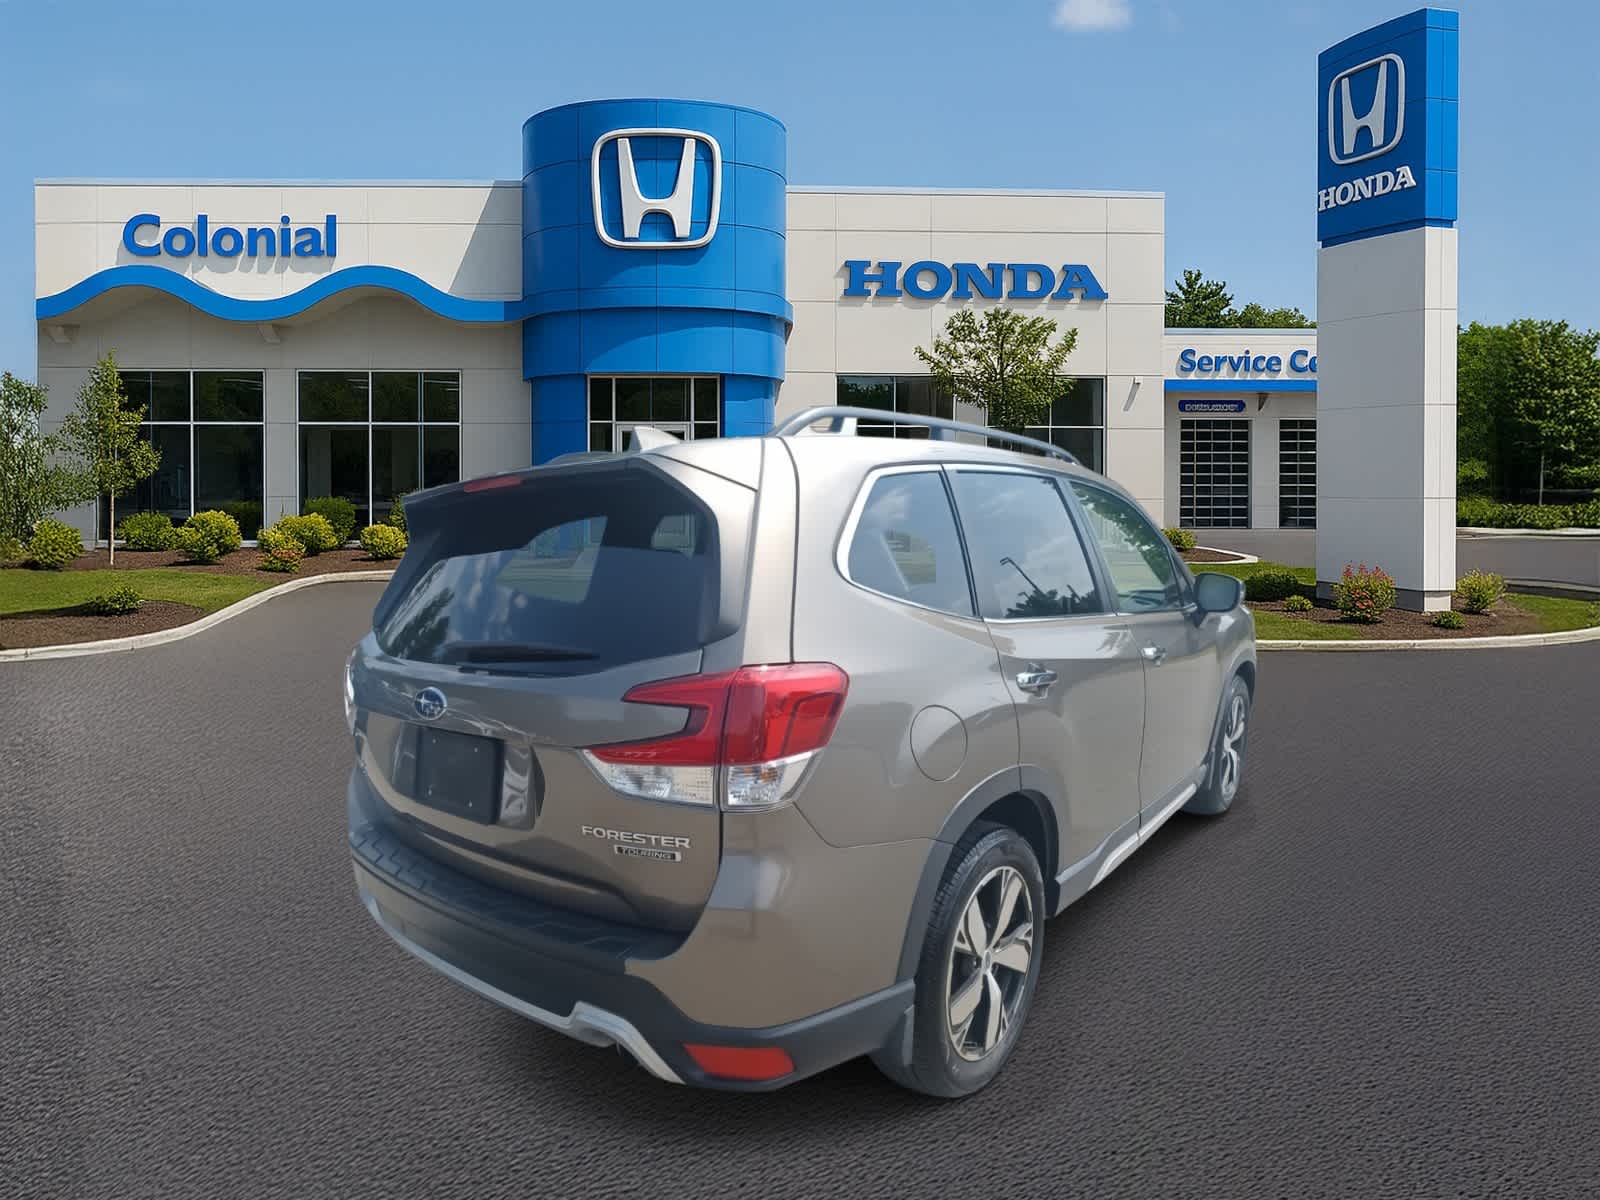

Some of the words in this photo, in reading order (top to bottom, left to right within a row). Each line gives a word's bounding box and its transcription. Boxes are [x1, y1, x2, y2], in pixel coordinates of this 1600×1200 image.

[1318, 165, 1417, 212] HONDA
[122, 213, 337, 258] Colonial
[843, 260, 1109, 300] HONDA
[1179, 348, 1282, 373] Service
[581, 825, 691, 848] FORESTER
